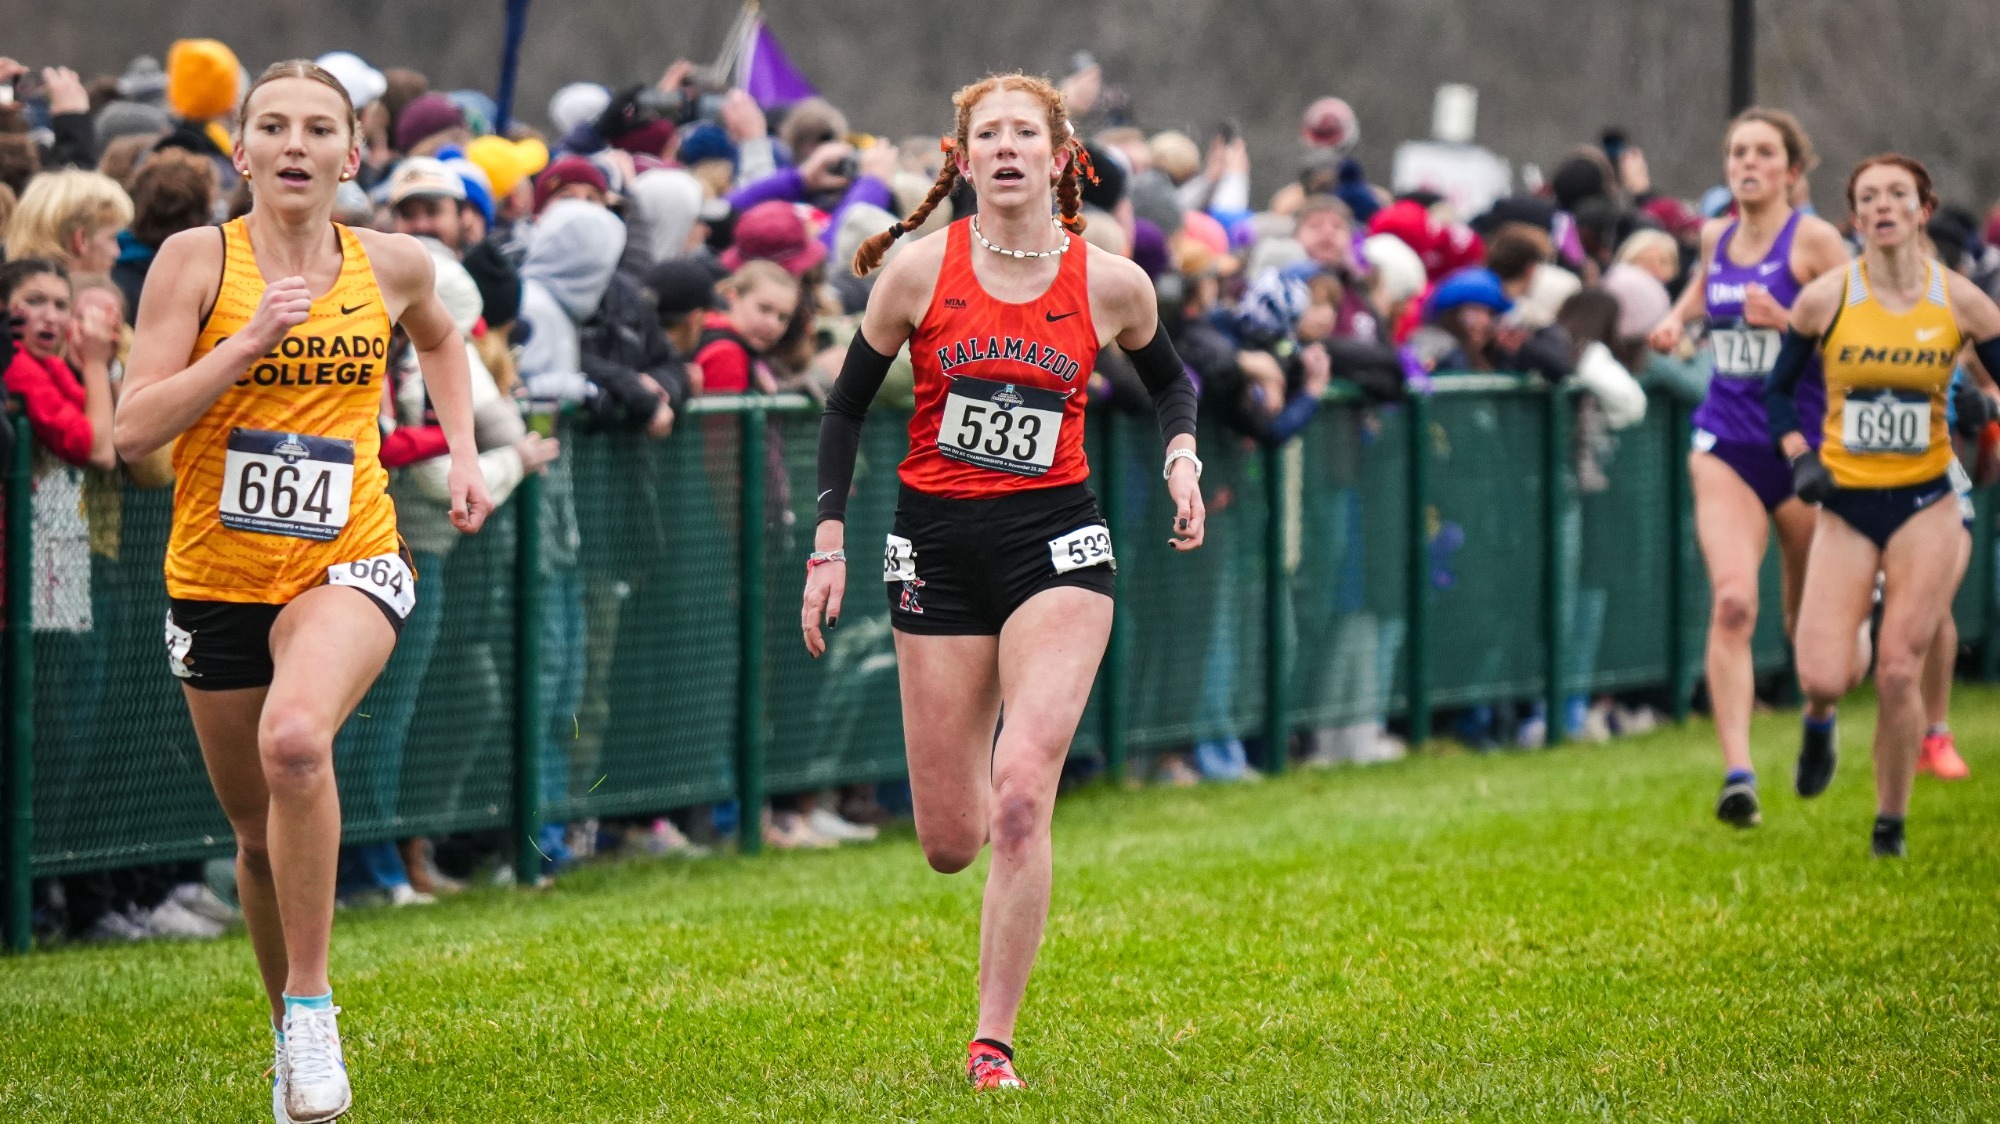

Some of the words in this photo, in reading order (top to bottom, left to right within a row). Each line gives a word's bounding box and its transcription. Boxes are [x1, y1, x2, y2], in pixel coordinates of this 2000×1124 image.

[945, 298, 966, 307] MIAA
[214, 336, 385, 360] ORADO
[937, 336, 1080, 382] KALAMAZOO
[1723, 334, 1768, 372] 747
[1838, 346, 1955, 366] EMORY
[957, 404, 1042, 461] 533
[1857, 406, 1918, 447] 690
[239, 460, 333, 523] 664
[1068, 532, 1111, 565] 533
[349, 558, 403, 598] 664
